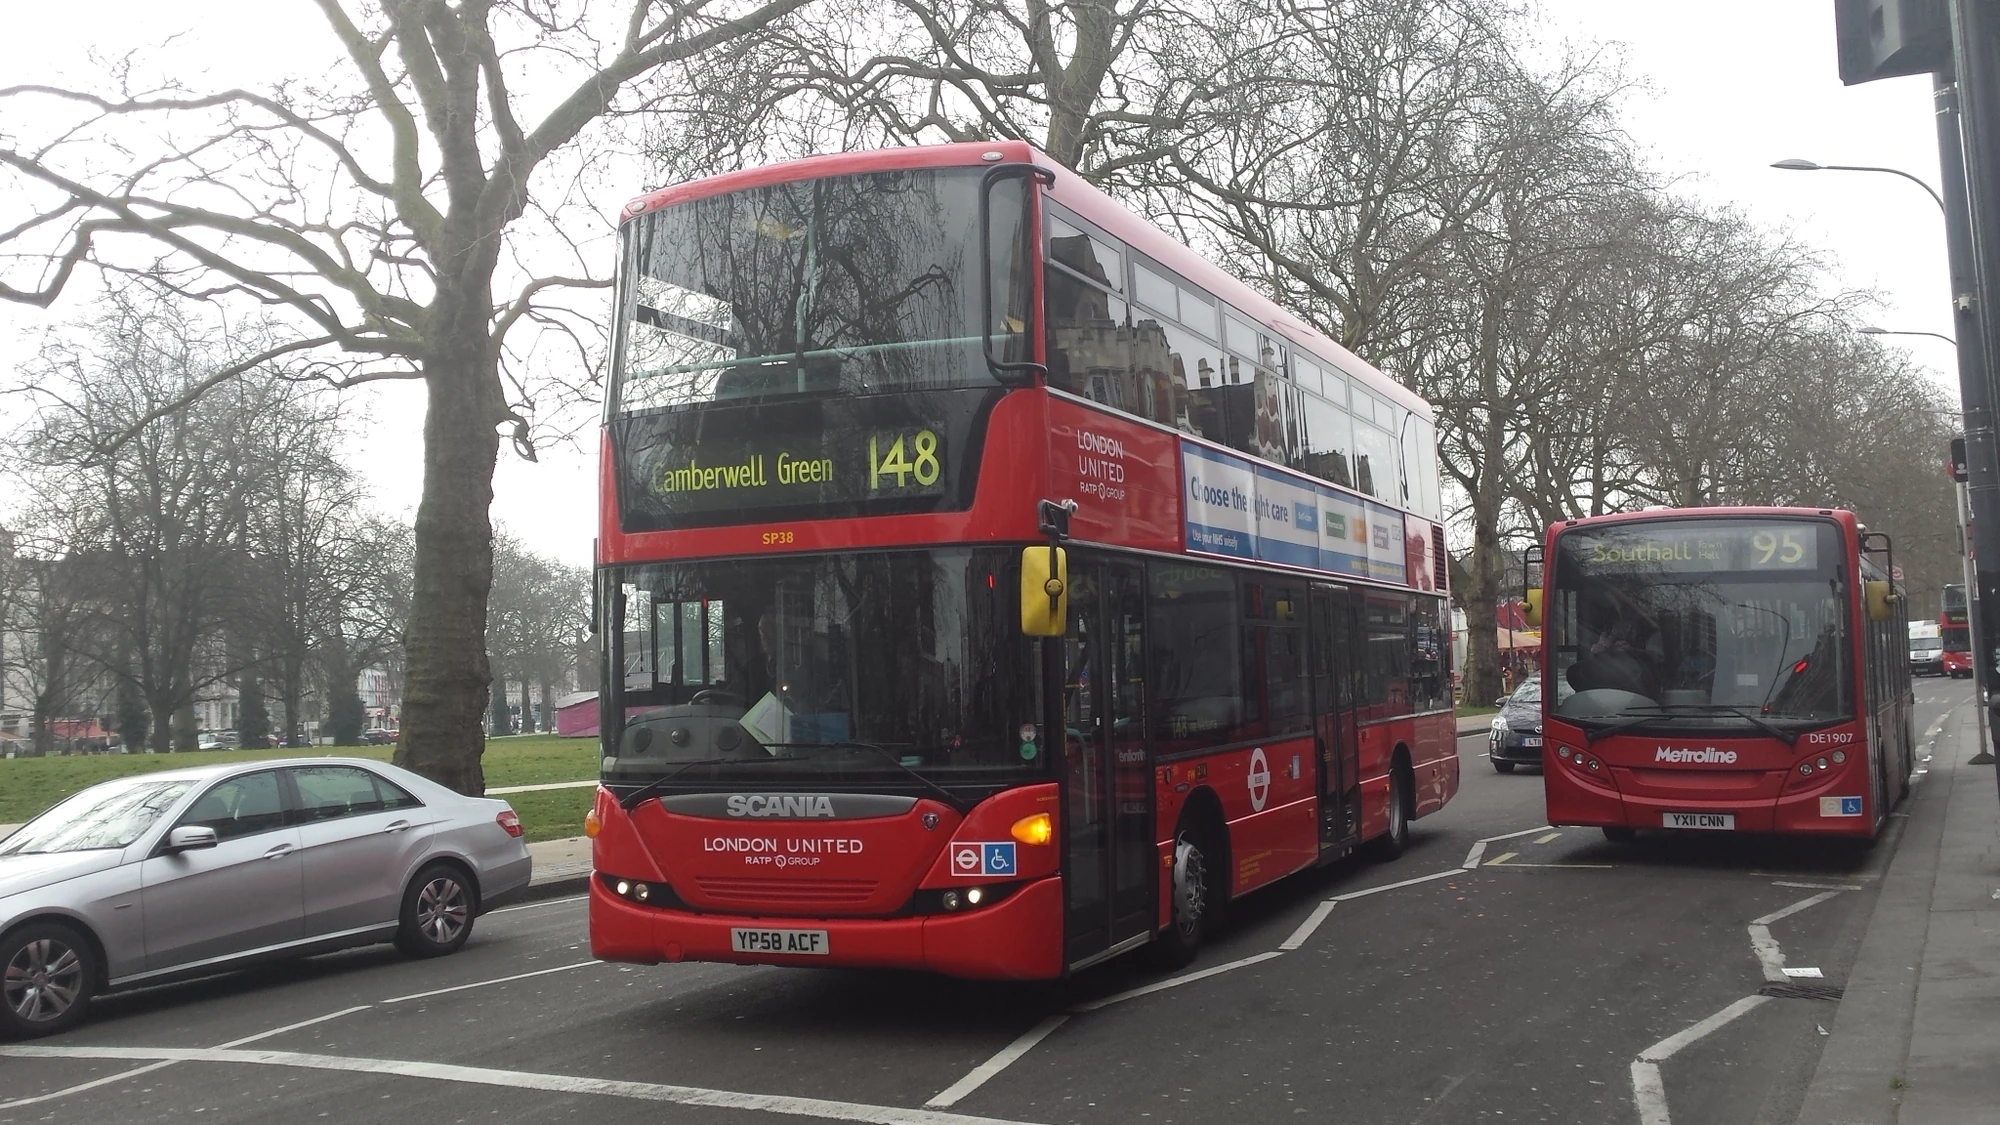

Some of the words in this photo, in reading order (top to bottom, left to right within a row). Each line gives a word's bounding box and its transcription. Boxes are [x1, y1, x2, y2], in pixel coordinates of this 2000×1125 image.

[1077, 429, 1124, 459] LONDON
[777, 451, 833, 486] Green
[869, 429, 941, 490] 148
[1078, 455, 1124, 483] UNITED
[1079, 481, 1098, 495] RATP
[1106, 486, 1126, 501] GROUP
[1191, 476, 1230, 508] Choose
[1232, 486, 1248, 513] the
[1271, 503, 1289, 523] care
[762, 531, 794, 545] SP38
[1192, 528, 1202, 542] Use
[1201, 532, 1213, 546] your
[1212, 532, 1225, 546] NHS
[1752, 530, 1804, 564] 95
[1592, 538, 1692, 565] Southall
[1698, 551, 1720, 561] Hall
[1809, 733, 1853, 744] DE1907
[1655, 746, 1737, 764] Metroline
[726, 795, 835, 818] SCANIA
[1673, 815, 1696, 827] YX11
[1699, 815, 1725, 827] CNN
[704, 837, 777, 853] LONDON
[786, 839, 863, 854] UNITED
[745, 856, 772, 865] RATP
[788, 856, 820, 866] GROUP
[737, 931, 782, 949] YP58
[788, 933, 820, 951] ACF
